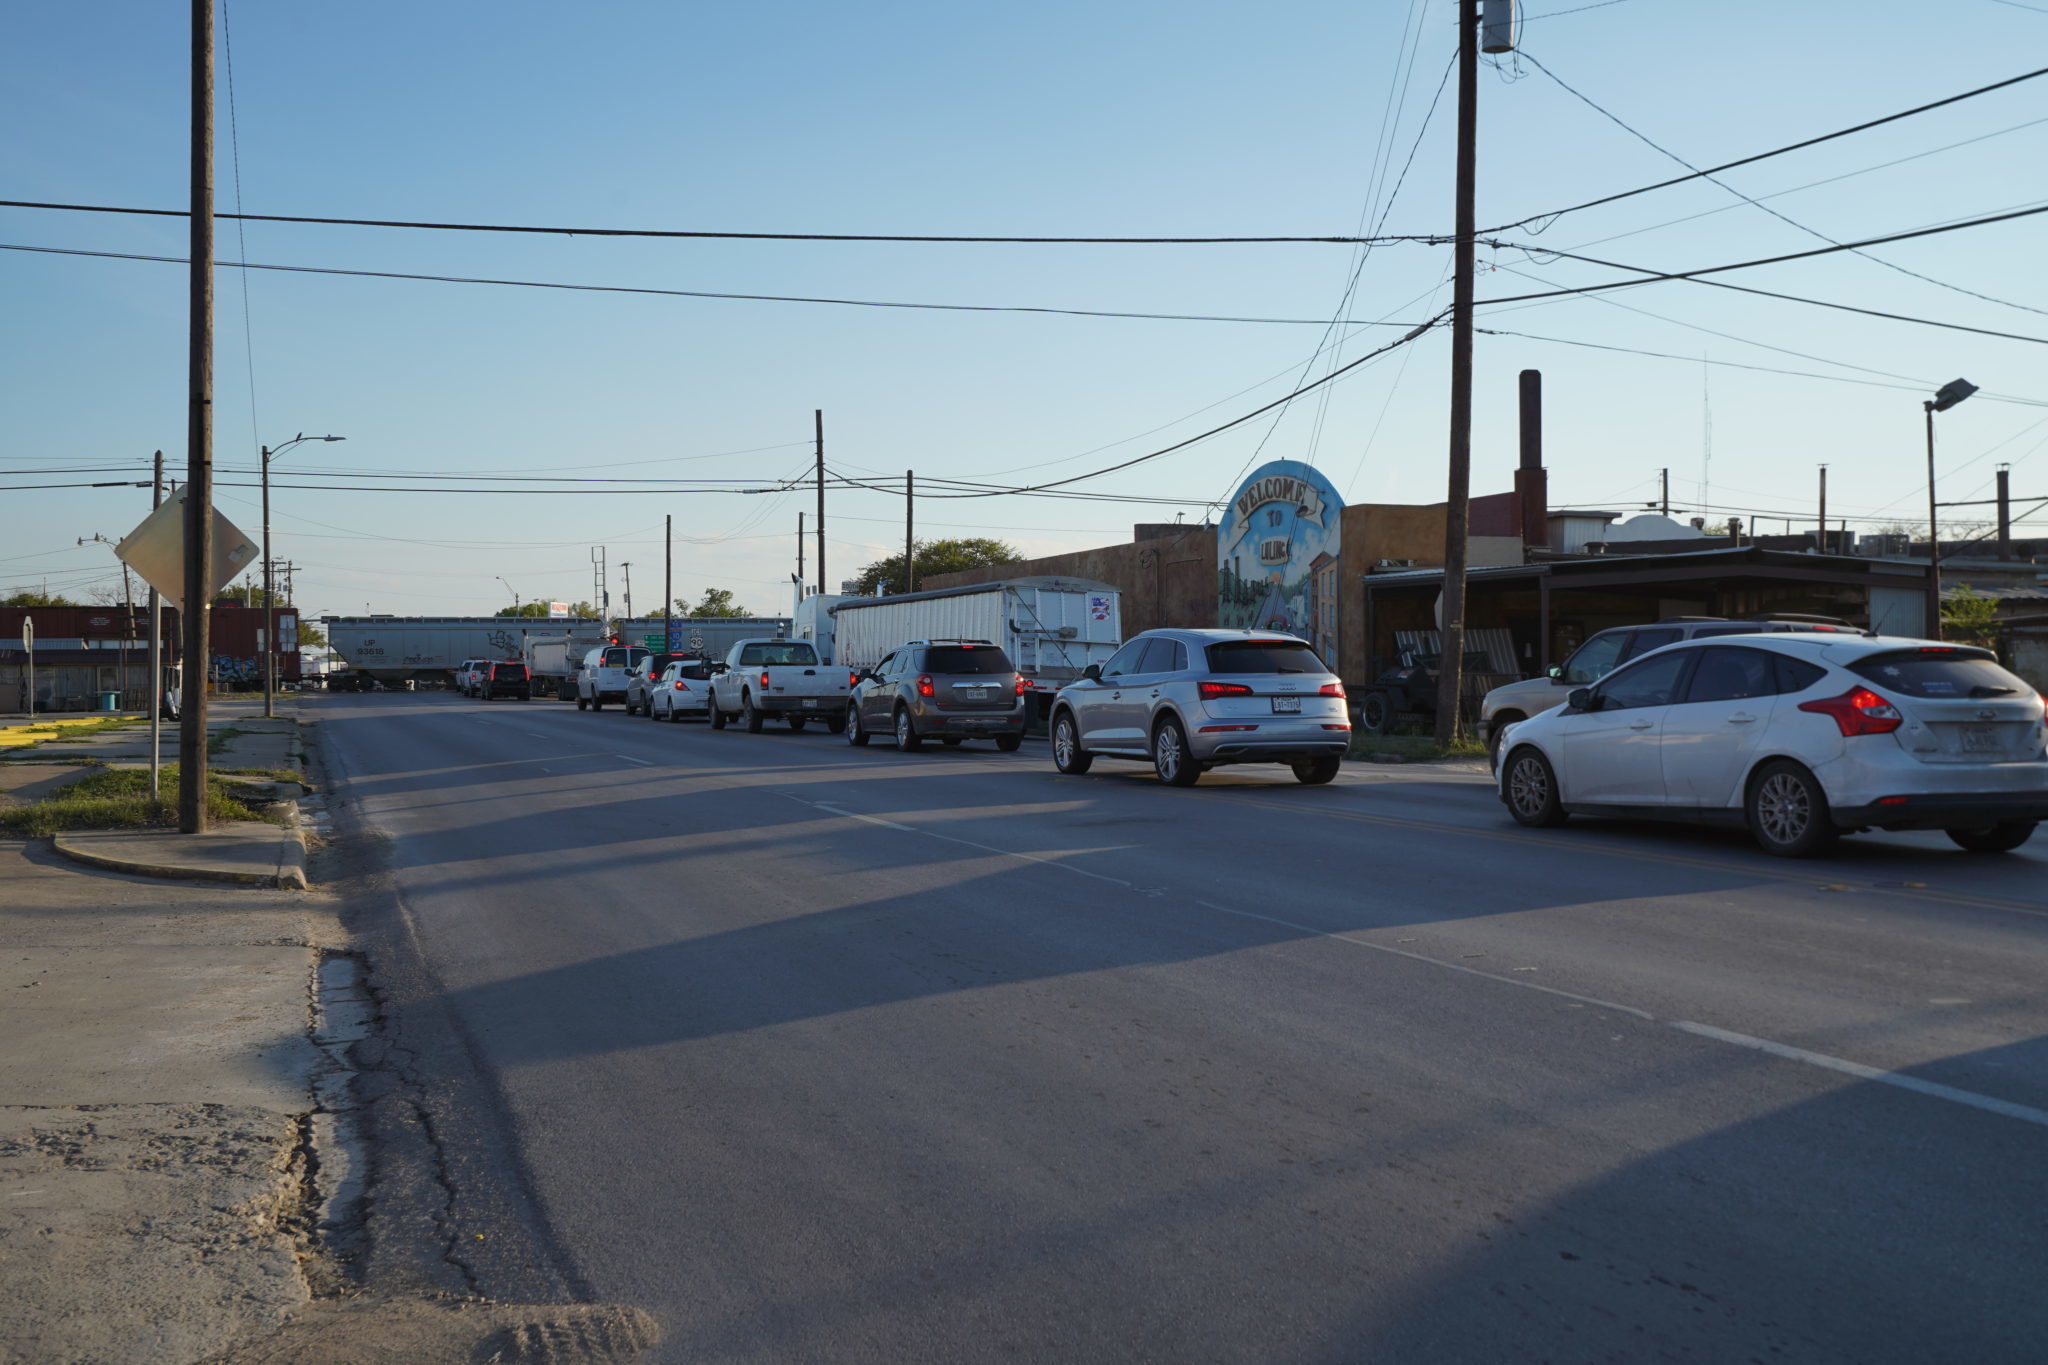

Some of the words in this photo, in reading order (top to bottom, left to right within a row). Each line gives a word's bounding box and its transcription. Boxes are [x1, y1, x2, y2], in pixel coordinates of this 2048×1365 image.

[1237, 478, 1307, 515] WELCOME
[1267, 510, 1282, 528] TO
[1261, 540, 1286, 560] LULING
[691, 638, 704, 646] 90
